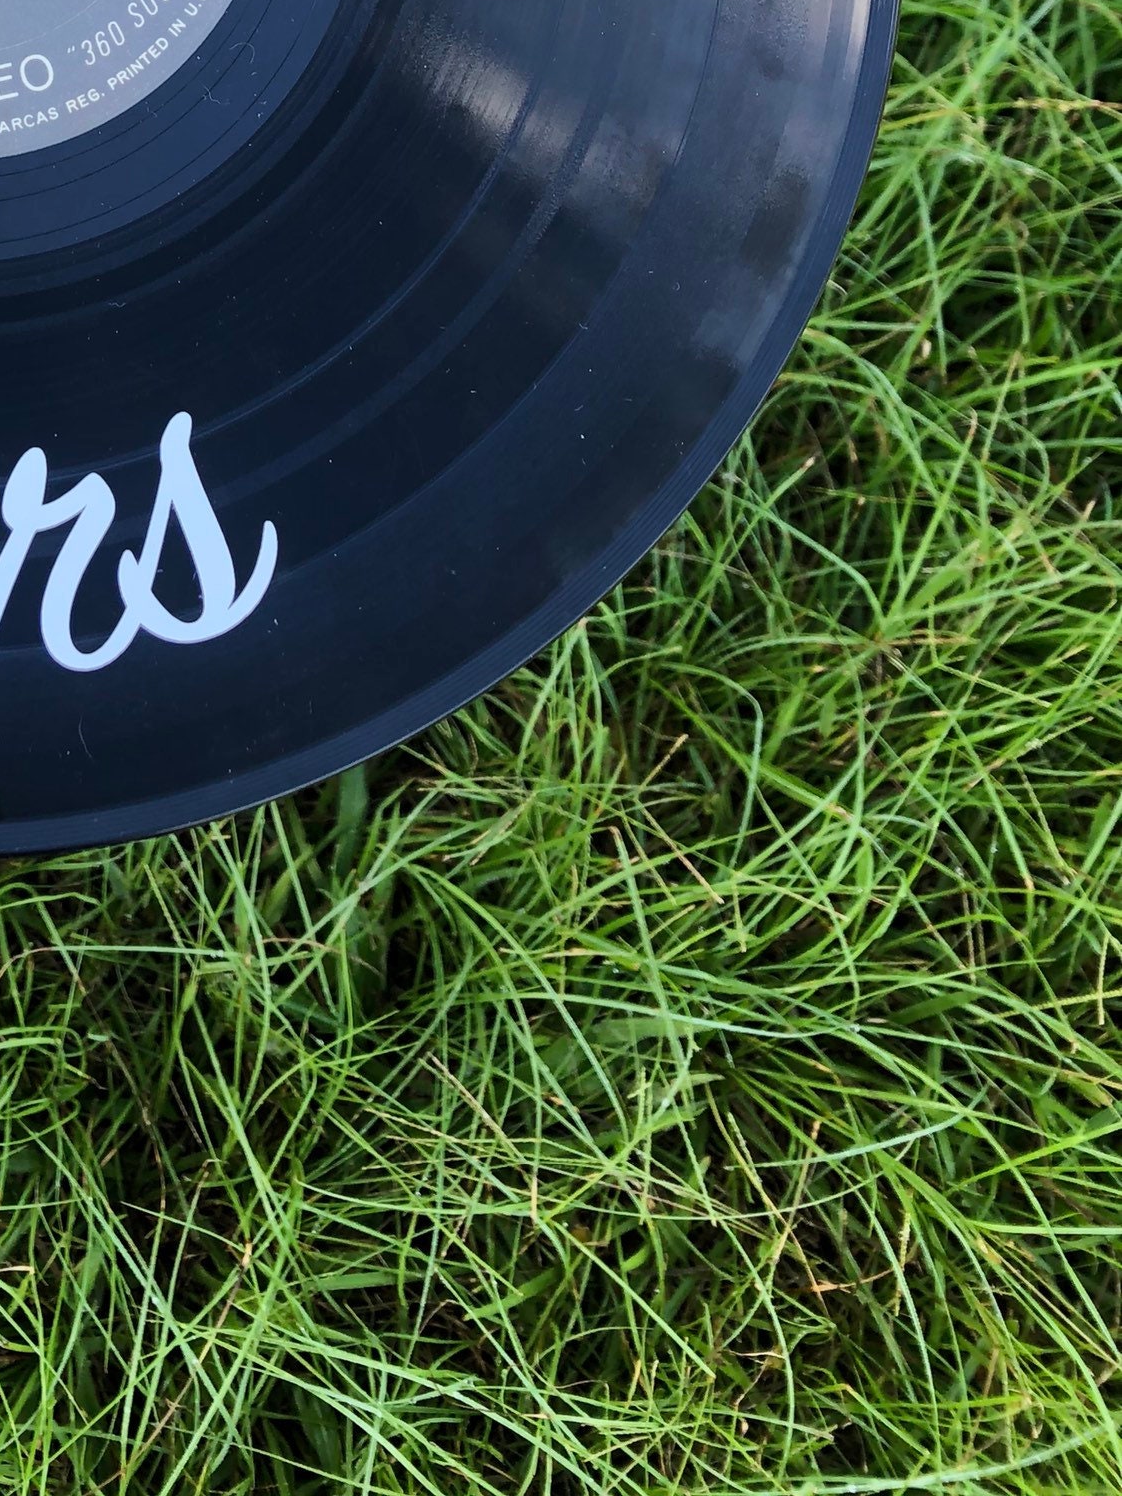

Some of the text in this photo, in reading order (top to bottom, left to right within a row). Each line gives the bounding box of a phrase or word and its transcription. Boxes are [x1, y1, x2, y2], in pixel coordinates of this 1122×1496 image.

[65, 87, 106, 113] REG.
[107, 36, 169, 91] PRINTED
[168, 18, 187, 37] IN
